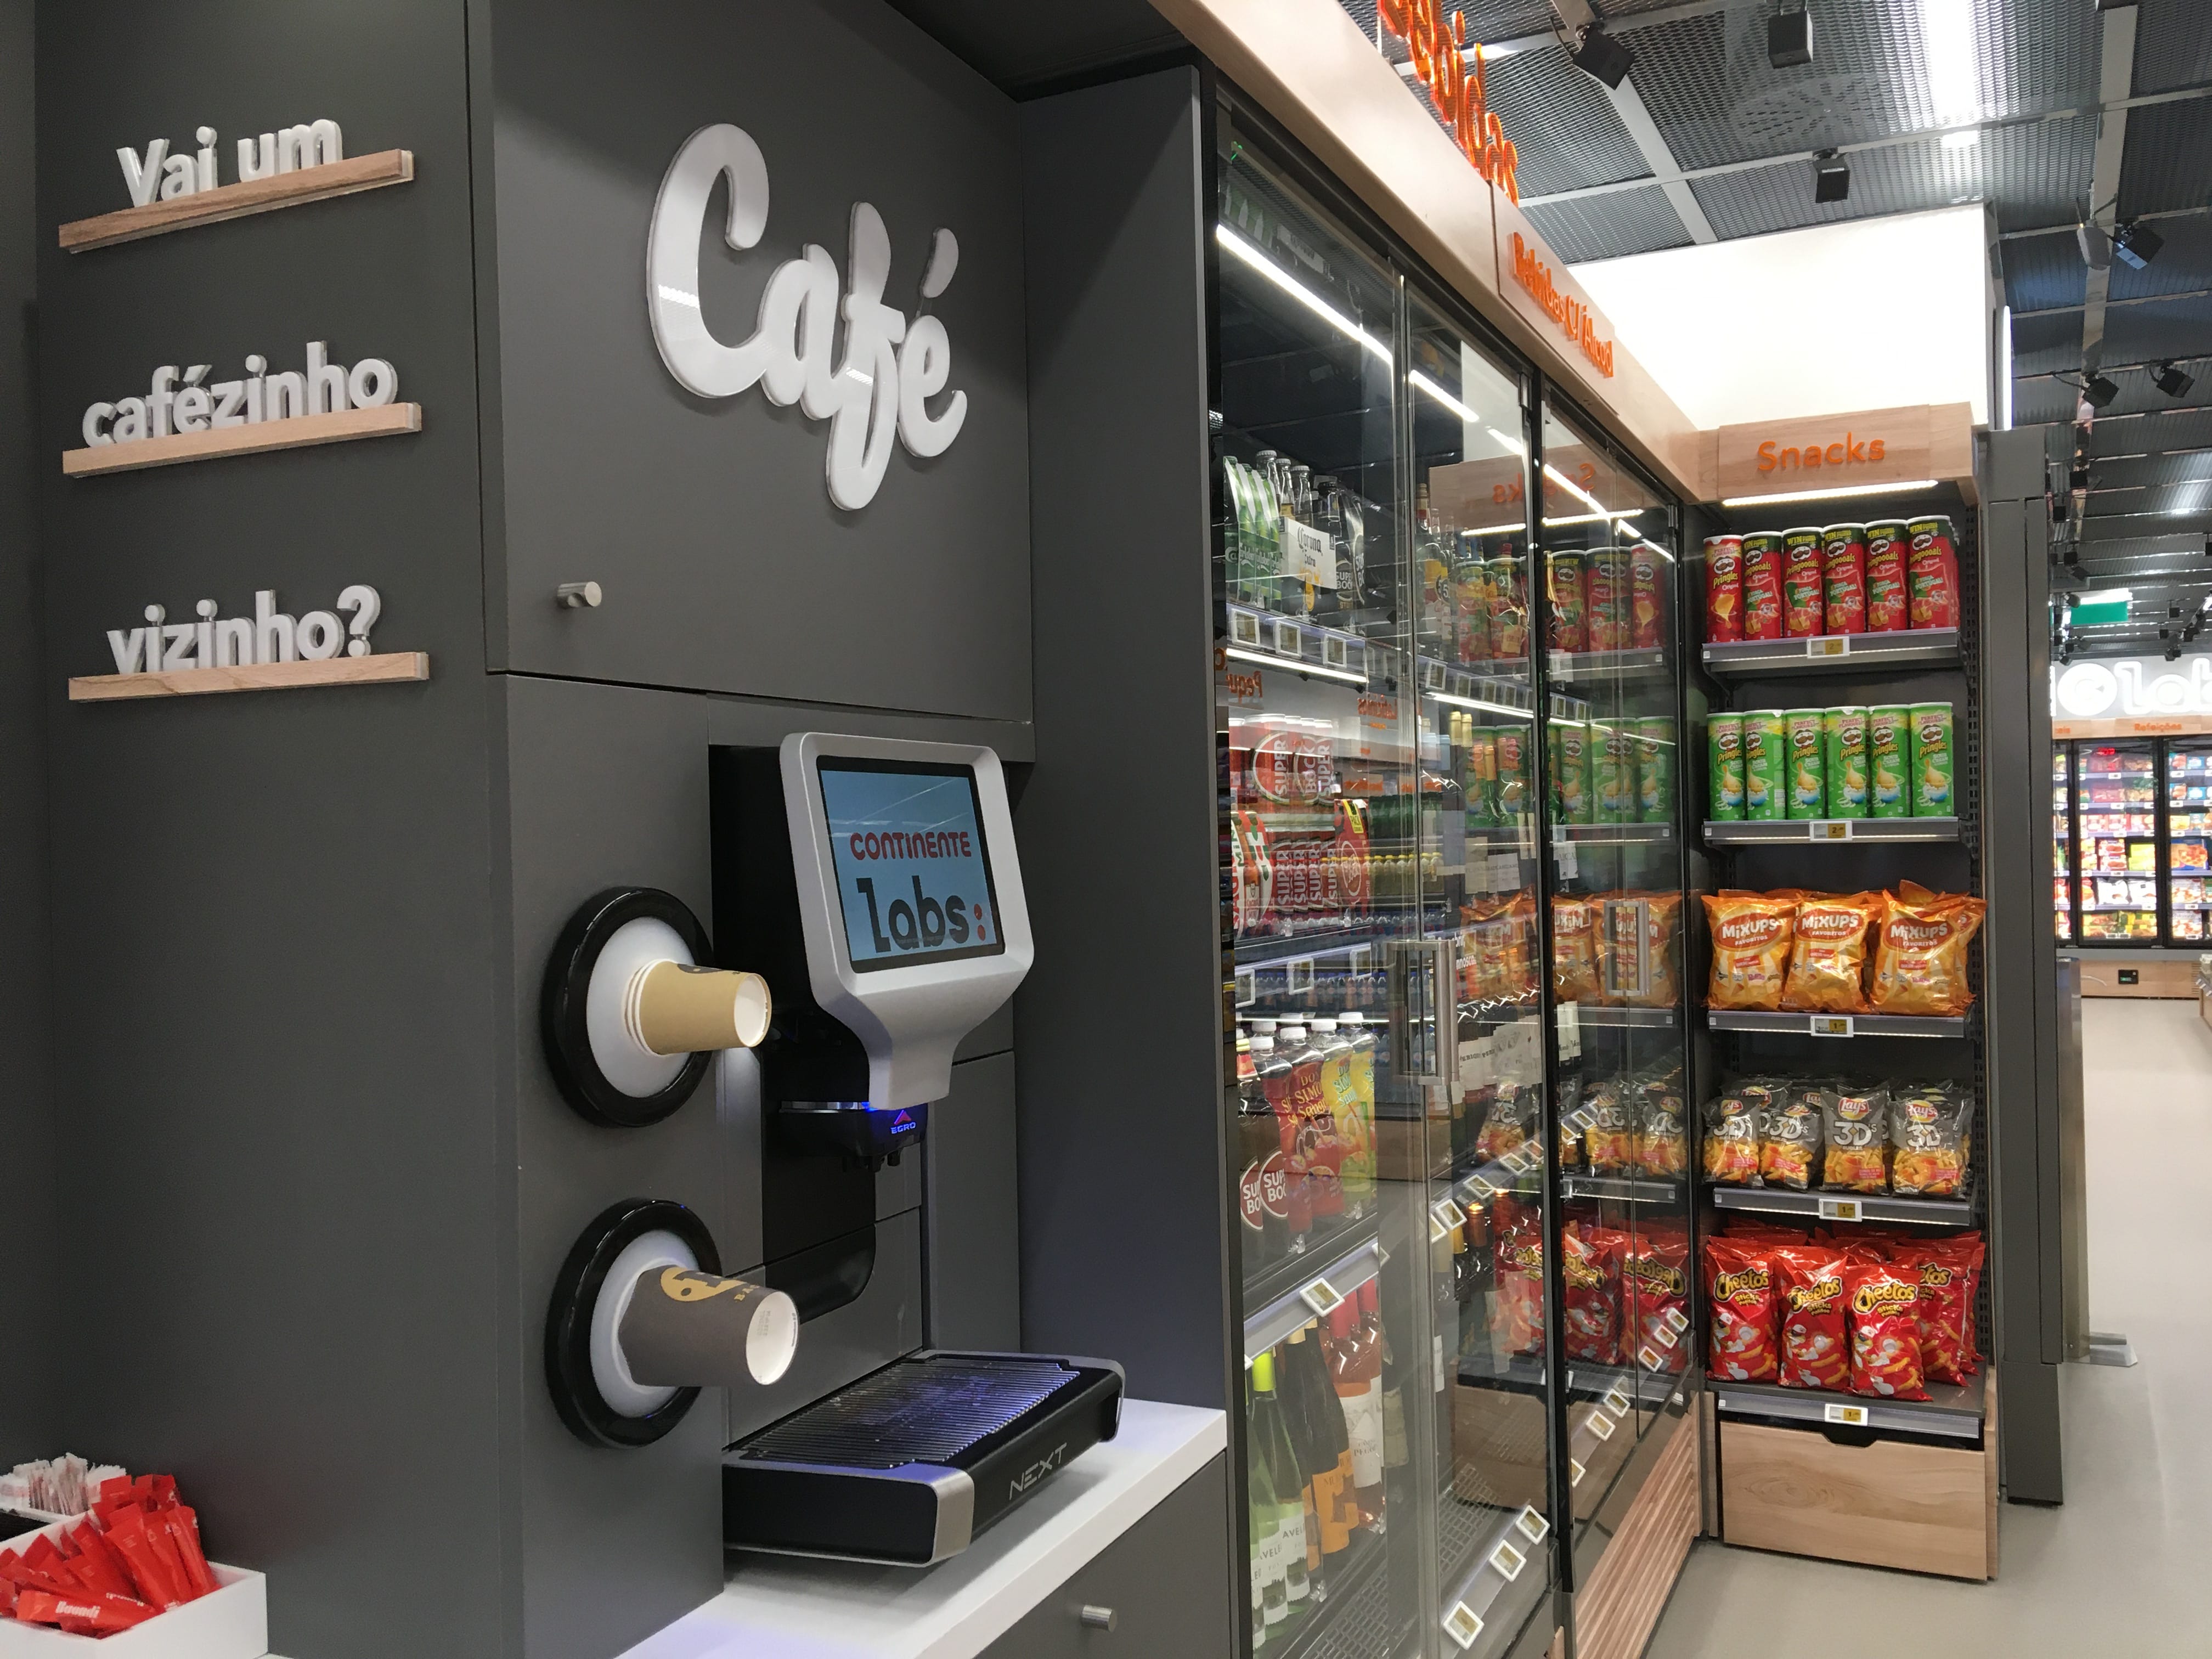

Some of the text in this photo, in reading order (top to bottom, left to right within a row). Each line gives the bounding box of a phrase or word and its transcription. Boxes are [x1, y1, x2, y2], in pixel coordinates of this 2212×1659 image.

[116, 119, 342, 207] Vai um
[646, 123, 967, 510] Café
[82, 341, 397, 448] cafézinho
[1757, 432, 1885, 471] Snacks
[1297, 527, 1323, 555] Corona
[1713, 572, 1738, 589] Pringles
[107, 585, 381, 675] vizinho?
[2134, 722, 2182, 732] Refeições
[1793, 745, 1819, 763] Pringles
[1920, 740, 1947, 759] Pringles
[1274, 740, 1287, 795] SUPER
[850, 832, 972, 860] CONTINENTE
[1735, 935, 1768, 945] FAVORITOS
[1903, 939, 1938, 948] FAVORITOS
[890, 1122, 916, 1134] EGRO
[1833, 1121, 1877, 1146] 3D's
[1717, 1269, 1769, 1300] Cheetos
[1788, 1278, 1841, 1311] Cheetos
[1854, 1282, 1915, 1313] Cheetos
[1009, 1442, 1067, 1500] NEXT
